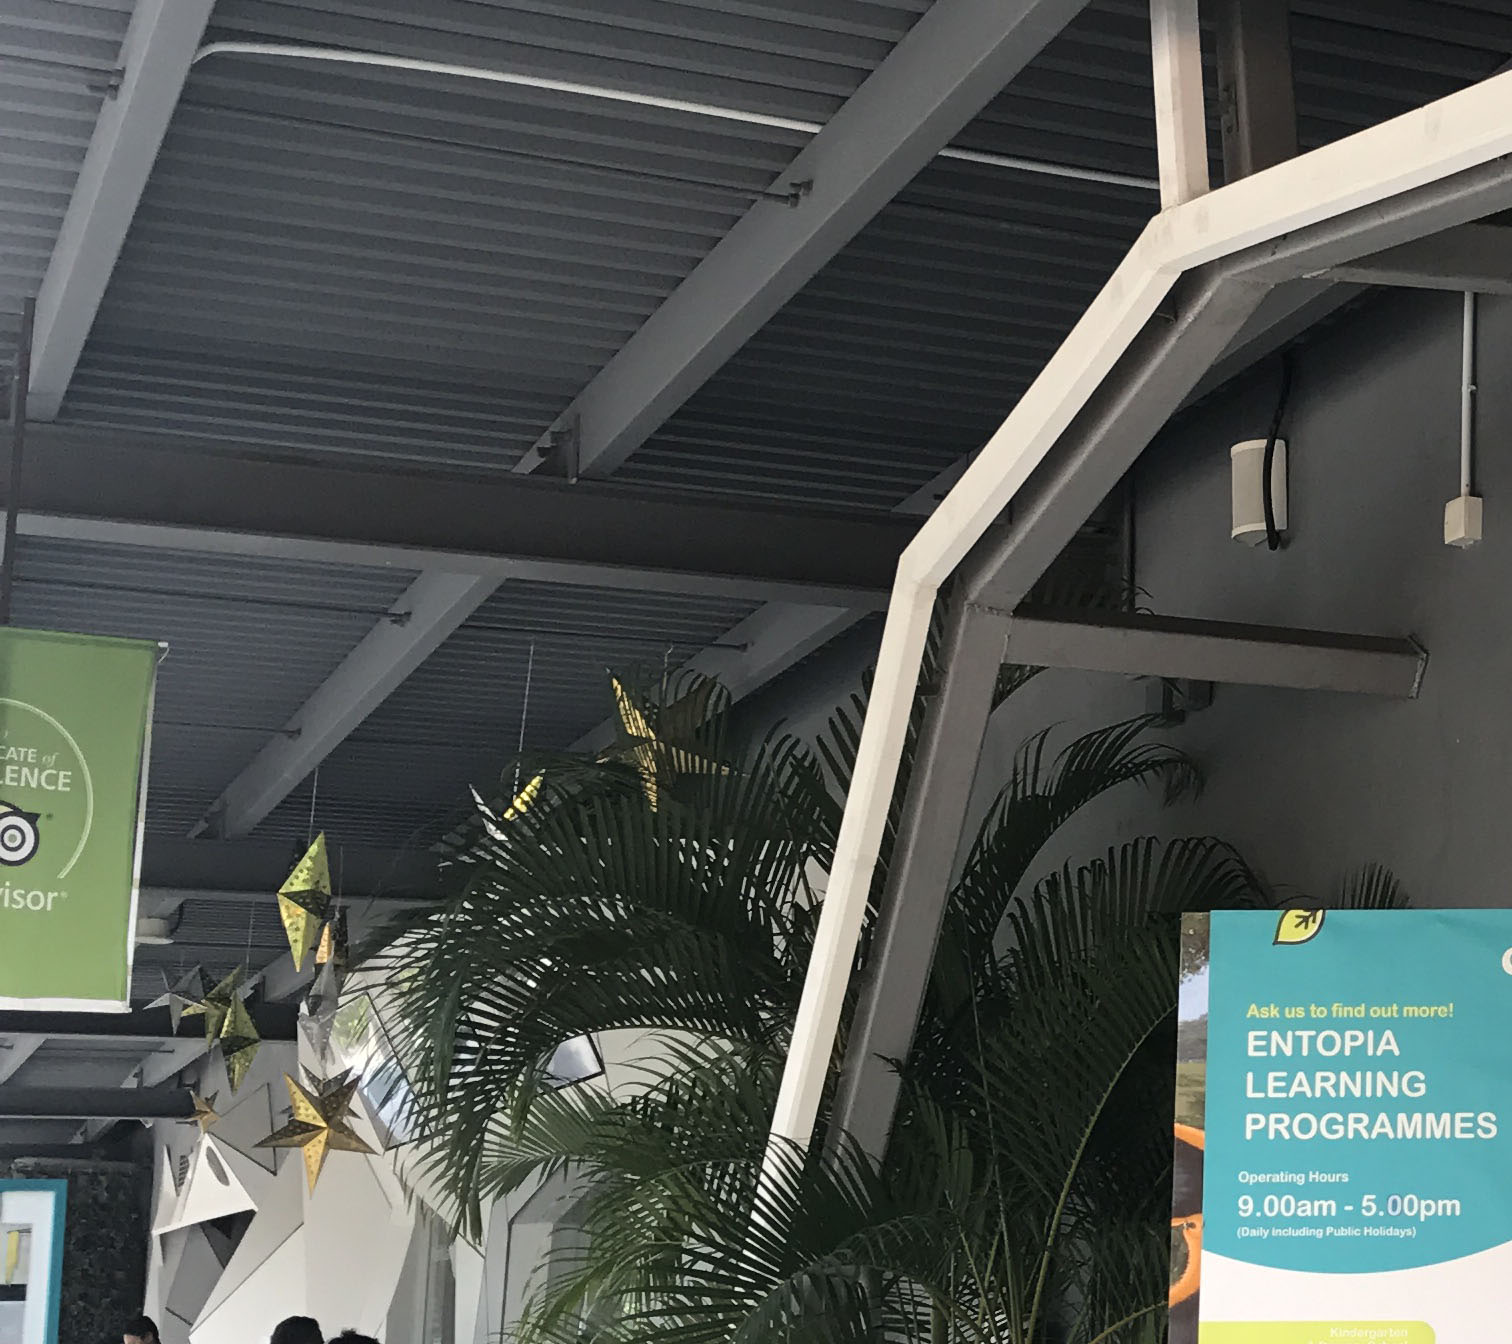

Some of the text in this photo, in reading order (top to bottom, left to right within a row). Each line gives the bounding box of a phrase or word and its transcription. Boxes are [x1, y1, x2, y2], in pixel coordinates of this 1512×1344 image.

[1247, 1002, 1454, 1018] Ask us to find out more!
[1247, 1030, 1400, 1057] ENTOPIA
[1246, 1071, 1426, 1098] LEARNING
[1245, 1111, 1498, 1140] PROGRAMMES
[1238, 1170, 1349, 1186] Operating Hours
[1238, 1194, 1337, 1217] 9.00am
[1362, 1193, 1460, 1223] 5.00pm
[1237, 1225, 1268, 1239] (Daily
[1325, 1225, 1360, 1238] Public
[1363, 1224, 1417, 1239] Holidays)
[1330, 1328, 1408, 1341] Kindergarten
